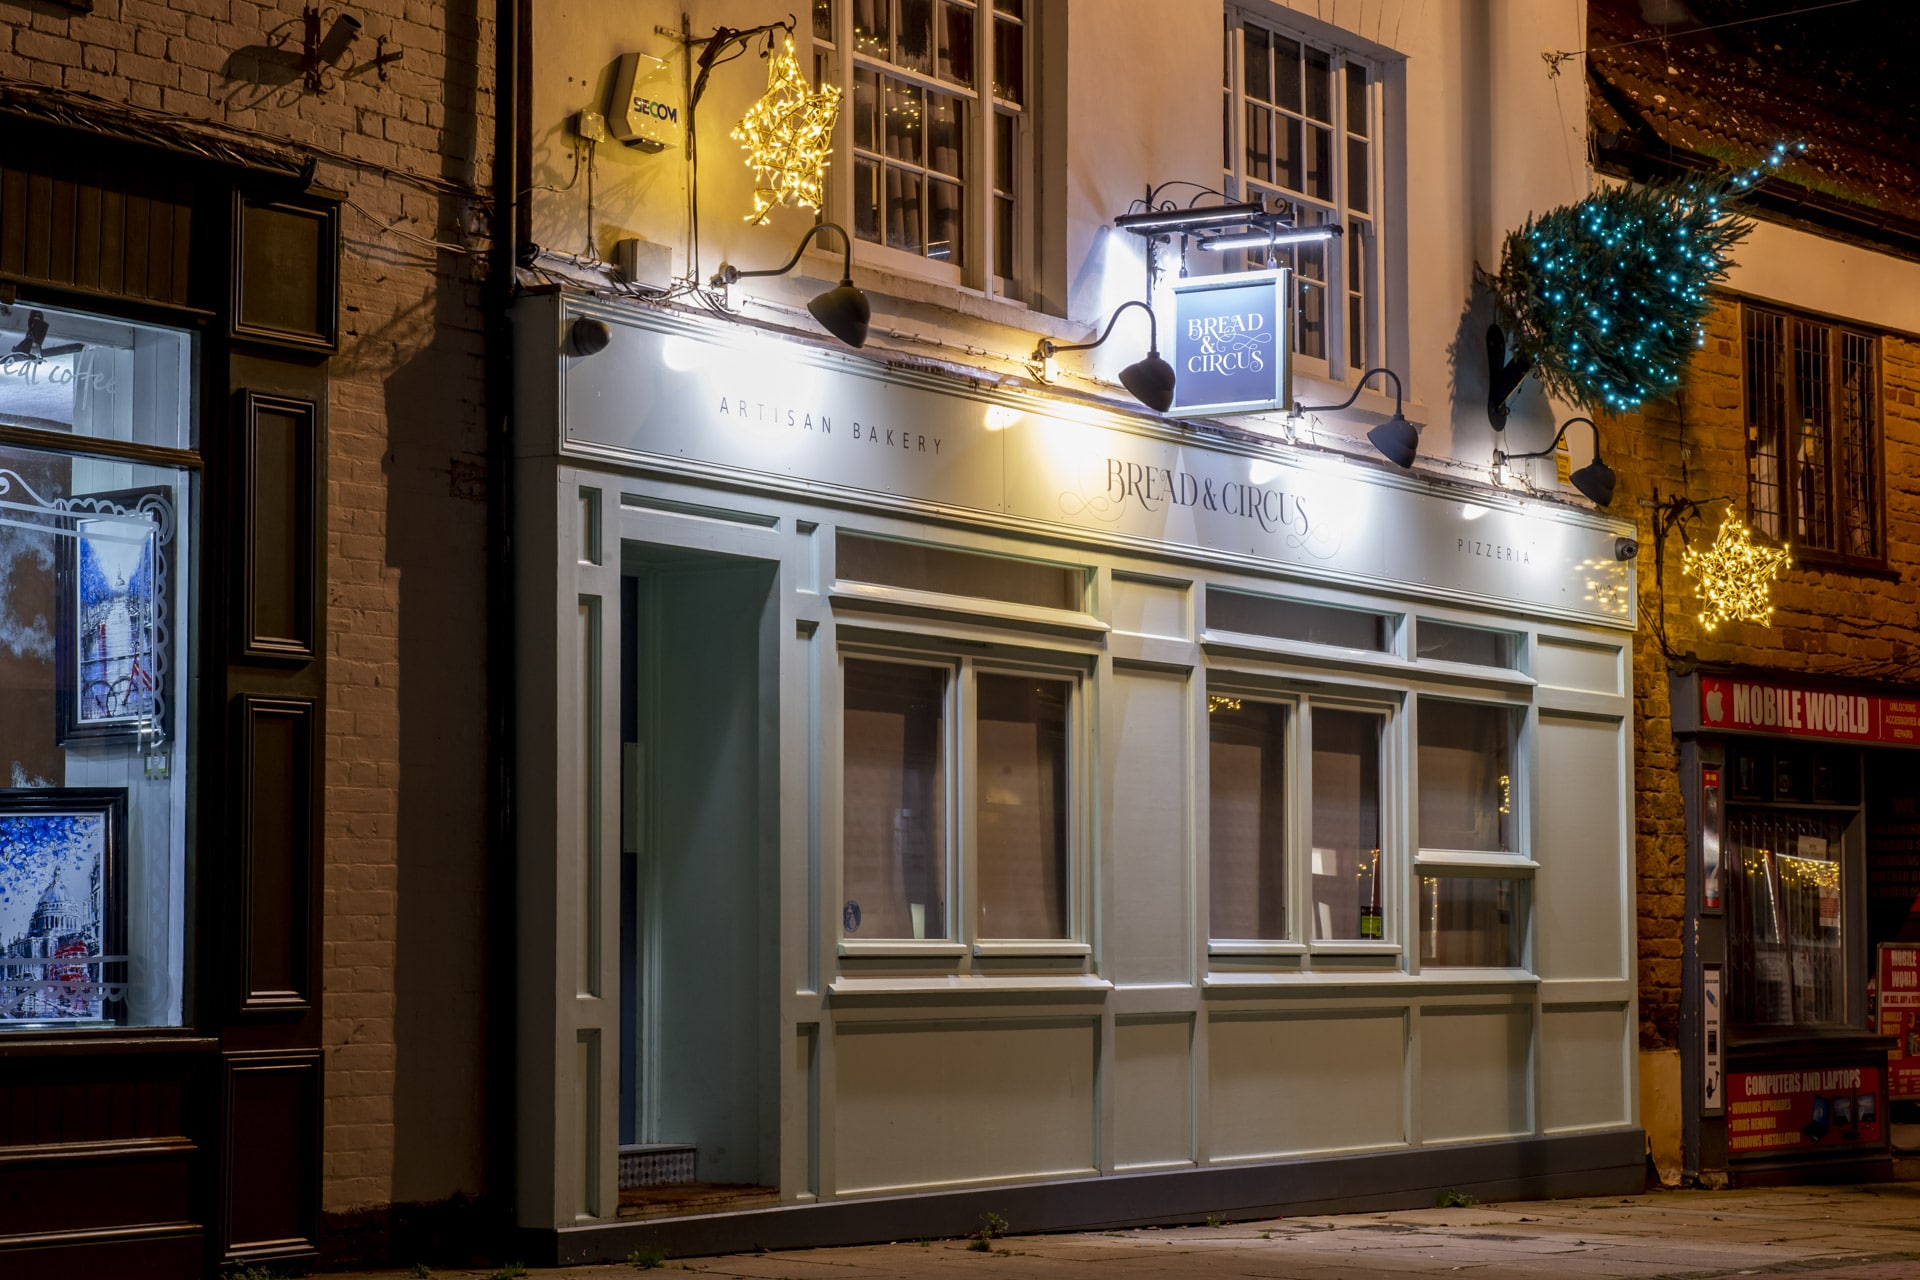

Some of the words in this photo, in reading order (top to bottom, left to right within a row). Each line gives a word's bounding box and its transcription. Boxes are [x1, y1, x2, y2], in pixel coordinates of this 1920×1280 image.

[633, 96, 677, 123] SECOM
[1188, 313, 1264, 342] BREAD
[1200, 335, 1217, 354] &
[1188, 350, 1264, 376] CIRCUS
[48, 343, 118, 411] coffee
[719, 396, 831, 434] ARTISAN
[852, 422, 941, 454] BAKERY
[1106, 458, 1198, 512] BREAD
[1222, 481, 1309, 536] CIRCUS
[1457, 538, 1529, 564] PIZZERIA
[1733, 684, 1802, 729] MOBILE
[1805, 691, 1869, 734] WORLD
[1891, 949, 1917, 967] MOBILE
[1891, 970, 1918, 988] WORLD
[1745, 1073, 1800, 1096] COMPUTERS
[1802, 1072, 1821, 1092] AND
[1823, 1069, 1860, 1090] LAPTOPS
